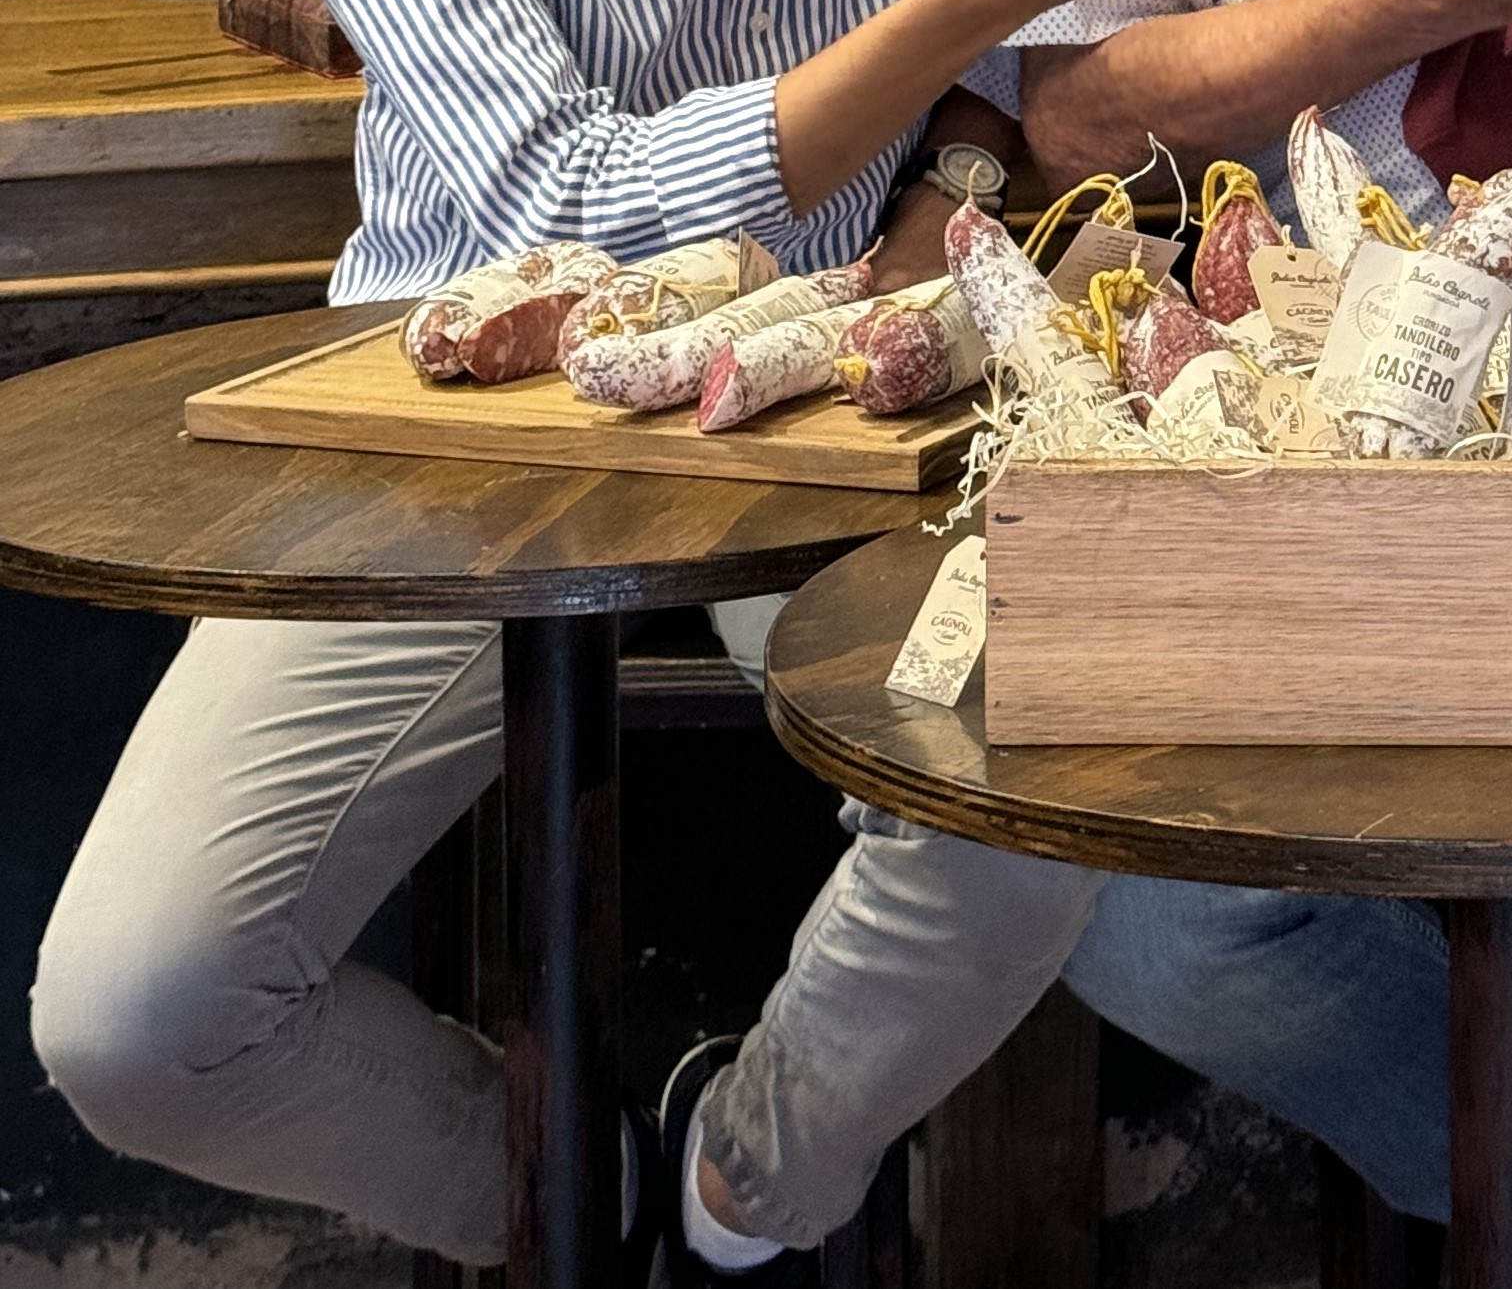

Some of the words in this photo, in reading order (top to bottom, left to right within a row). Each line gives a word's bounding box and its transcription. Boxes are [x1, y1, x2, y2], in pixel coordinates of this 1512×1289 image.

[1393, 324, 1461, 362] TANDILERO
[1411, 347, 1433, 363] TIPO
[1374, 353, 1456, 404] CASERO
[930, 616, 973, 637] CAGNOLI
